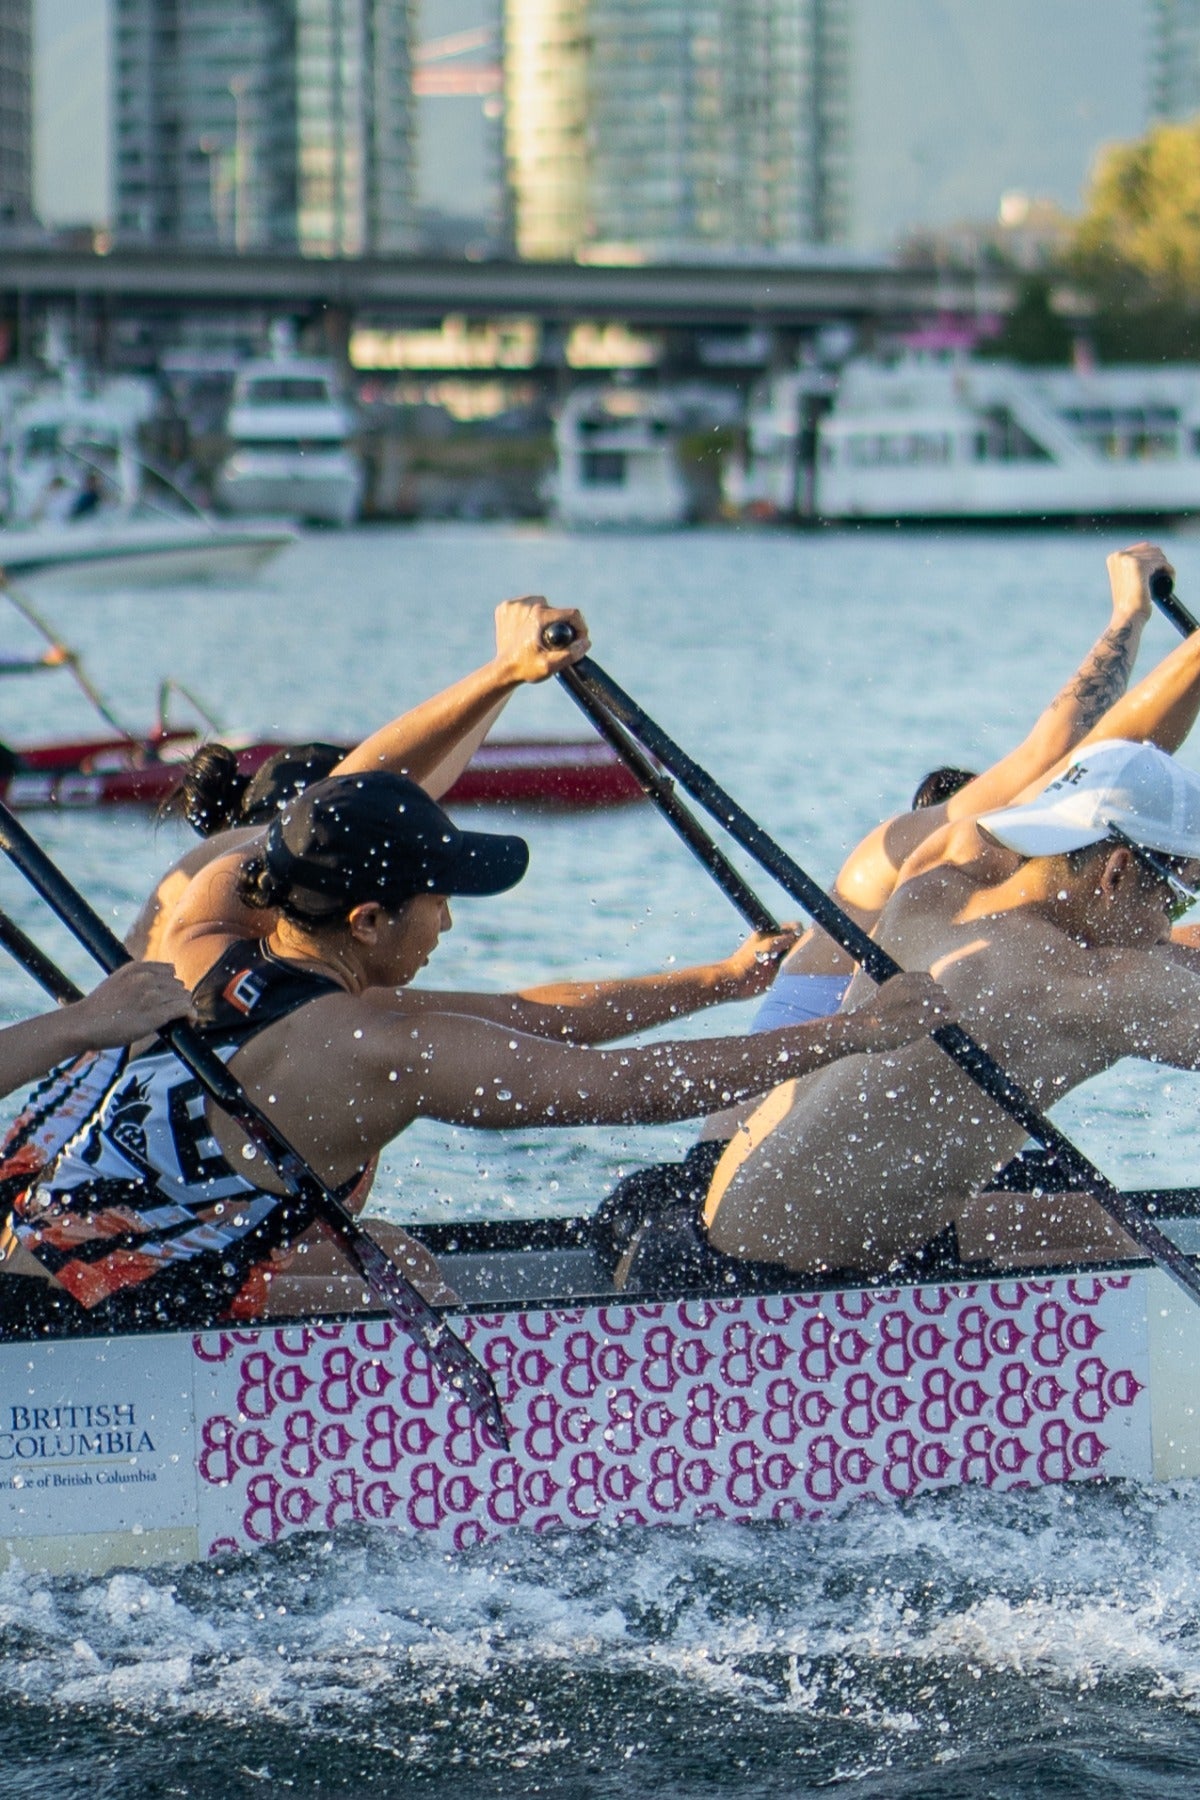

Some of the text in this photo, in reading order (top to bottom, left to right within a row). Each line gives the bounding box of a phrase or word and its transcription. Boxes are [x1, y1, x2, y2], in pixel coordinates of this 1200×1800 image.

[10, 1403, 136, 1432] BRITISH
[0, 1430, 156, 1460] COLUMBIA
[36, 1473, 51, 1488] of
[53, 1472, 92, 1487] British
[96, 1470, 157, 1485] Columbia
